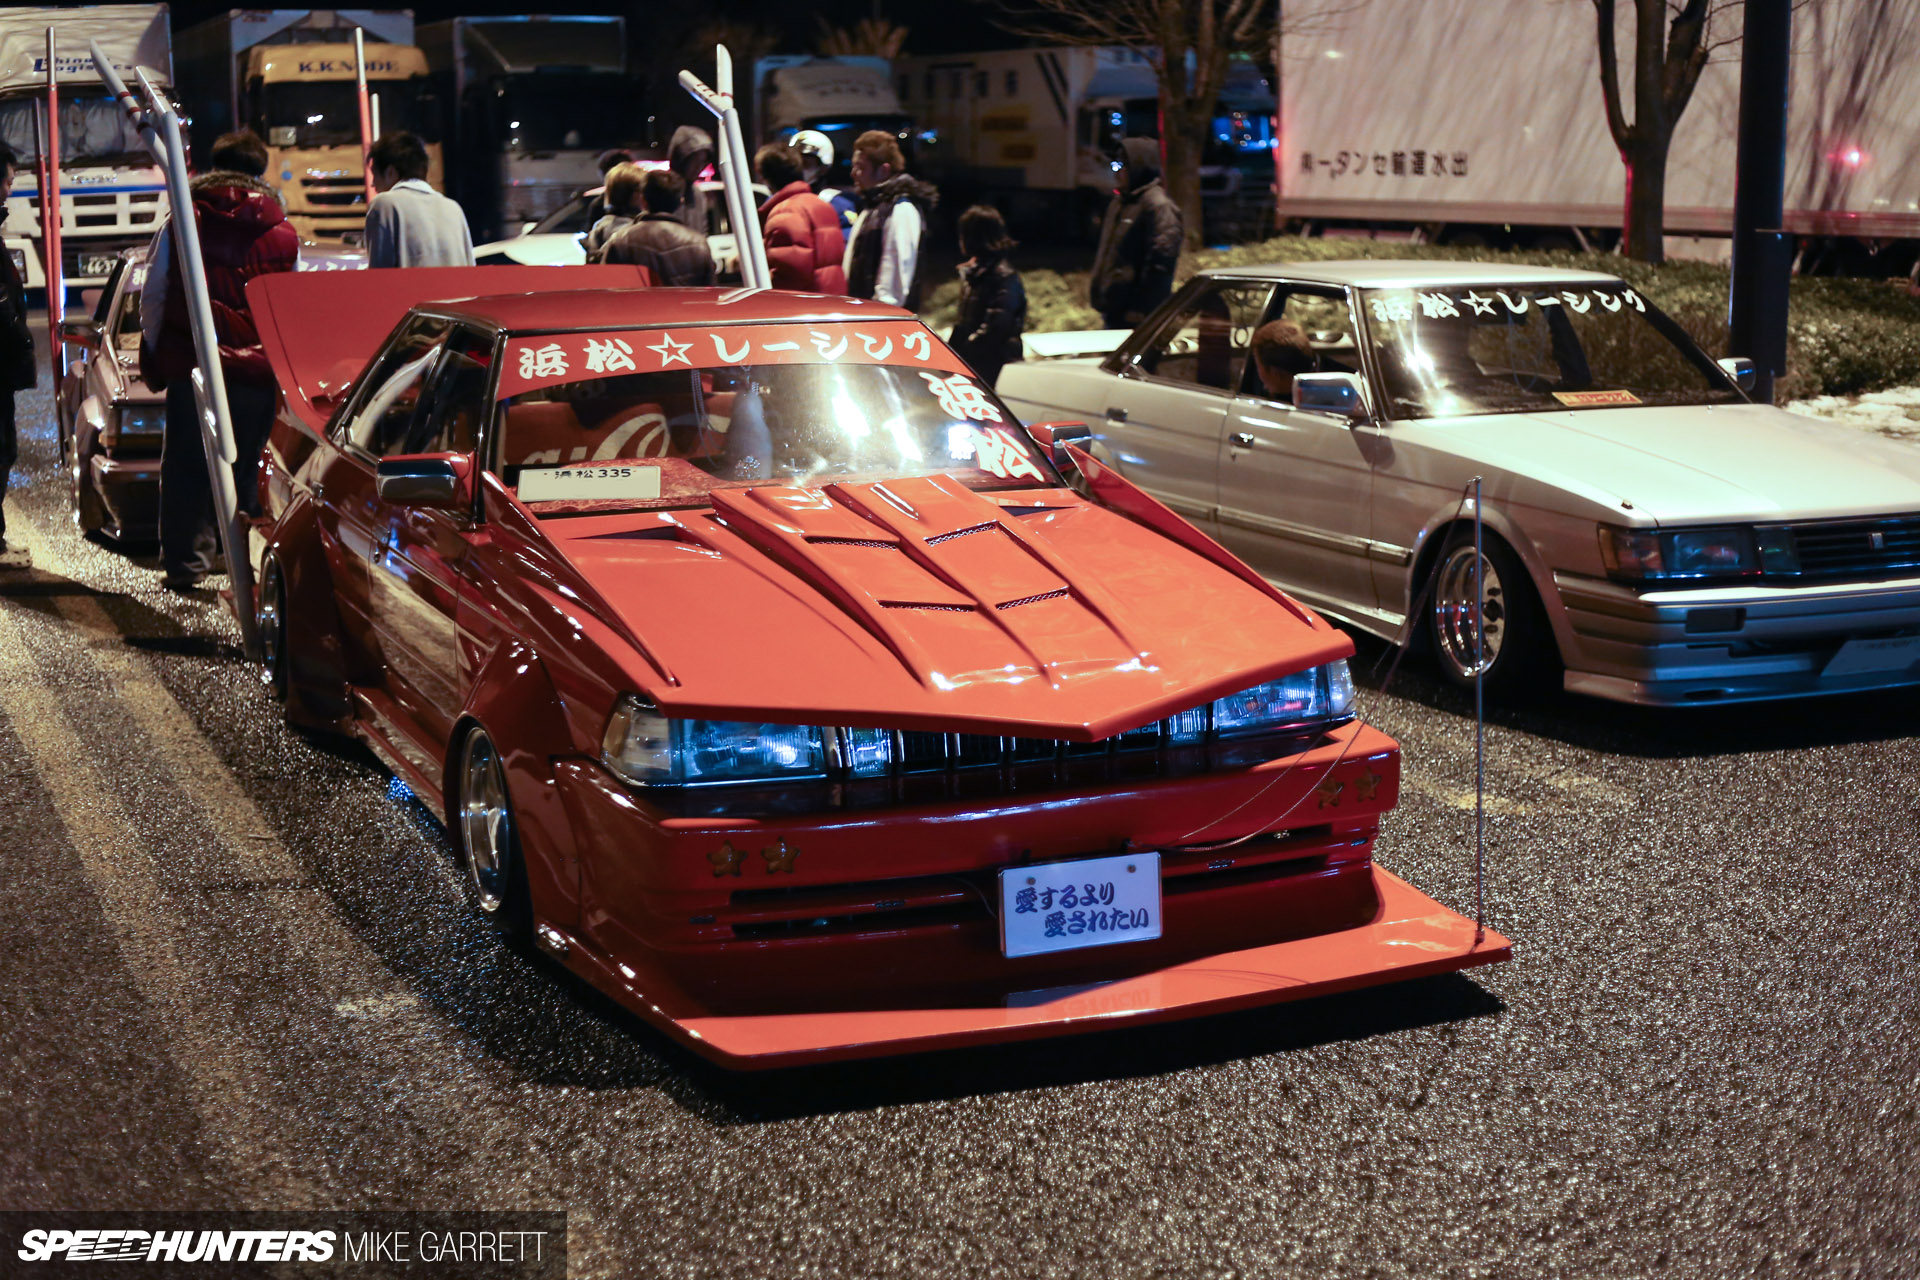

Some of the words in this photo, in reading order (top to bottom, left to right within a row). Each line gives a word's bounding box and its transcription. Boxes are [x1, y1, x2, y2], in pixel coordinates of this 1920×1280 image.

[1014, 881, 1115, 914] 愛するより
[1044, 907, 1150, 938] 愛されたい
